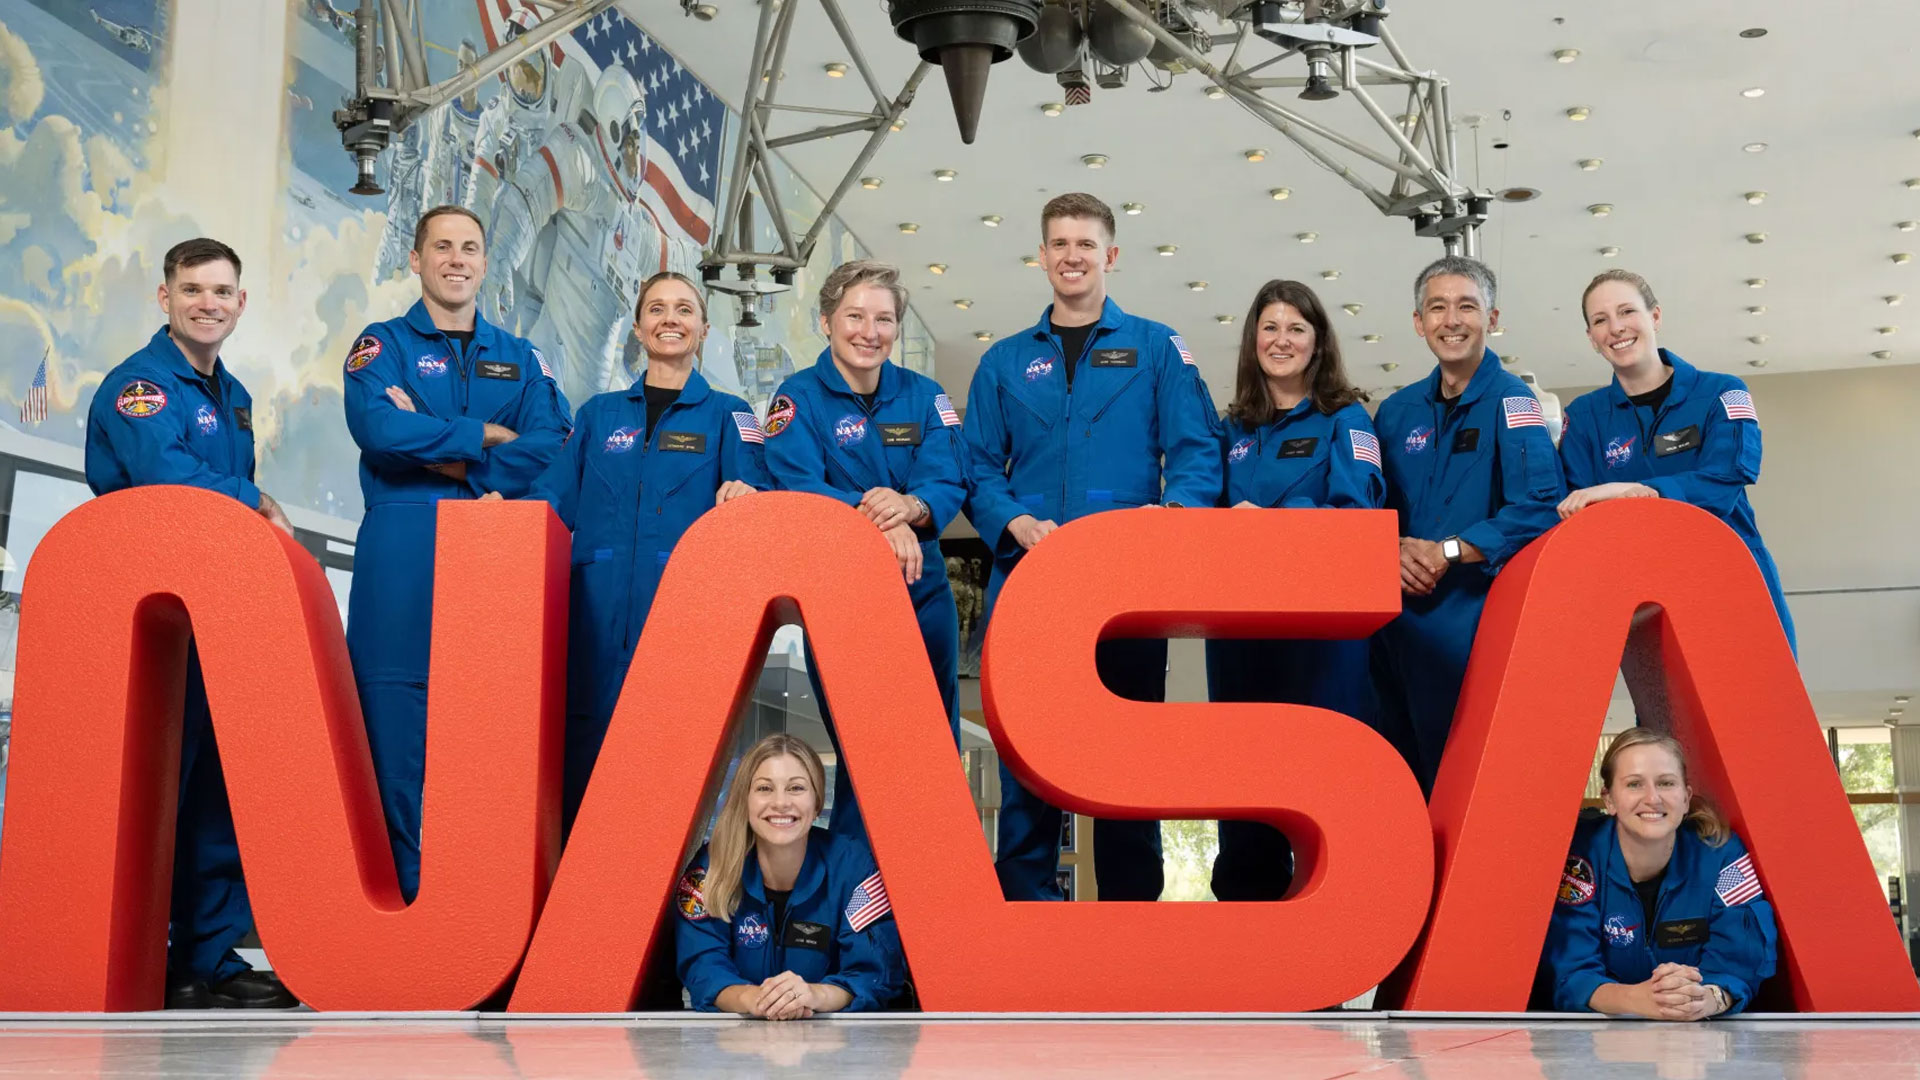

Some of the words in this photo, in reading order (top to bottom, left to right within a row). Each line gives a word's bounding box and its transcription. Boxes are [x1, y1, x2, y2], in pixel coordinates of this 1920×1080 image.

[1026, 363, 1053, 374] NASA
[197, 415, 217, 426] NASA
[836, 424, 866, 437] NASA
[607, 434, 634, 444] NASA
[1605, 446, 1631, 459] NASA
[0, 485, 1920, 1013] NASA
[738, 925, 769, 935] NASA
[1603, 923, 1634, 938] NASA
